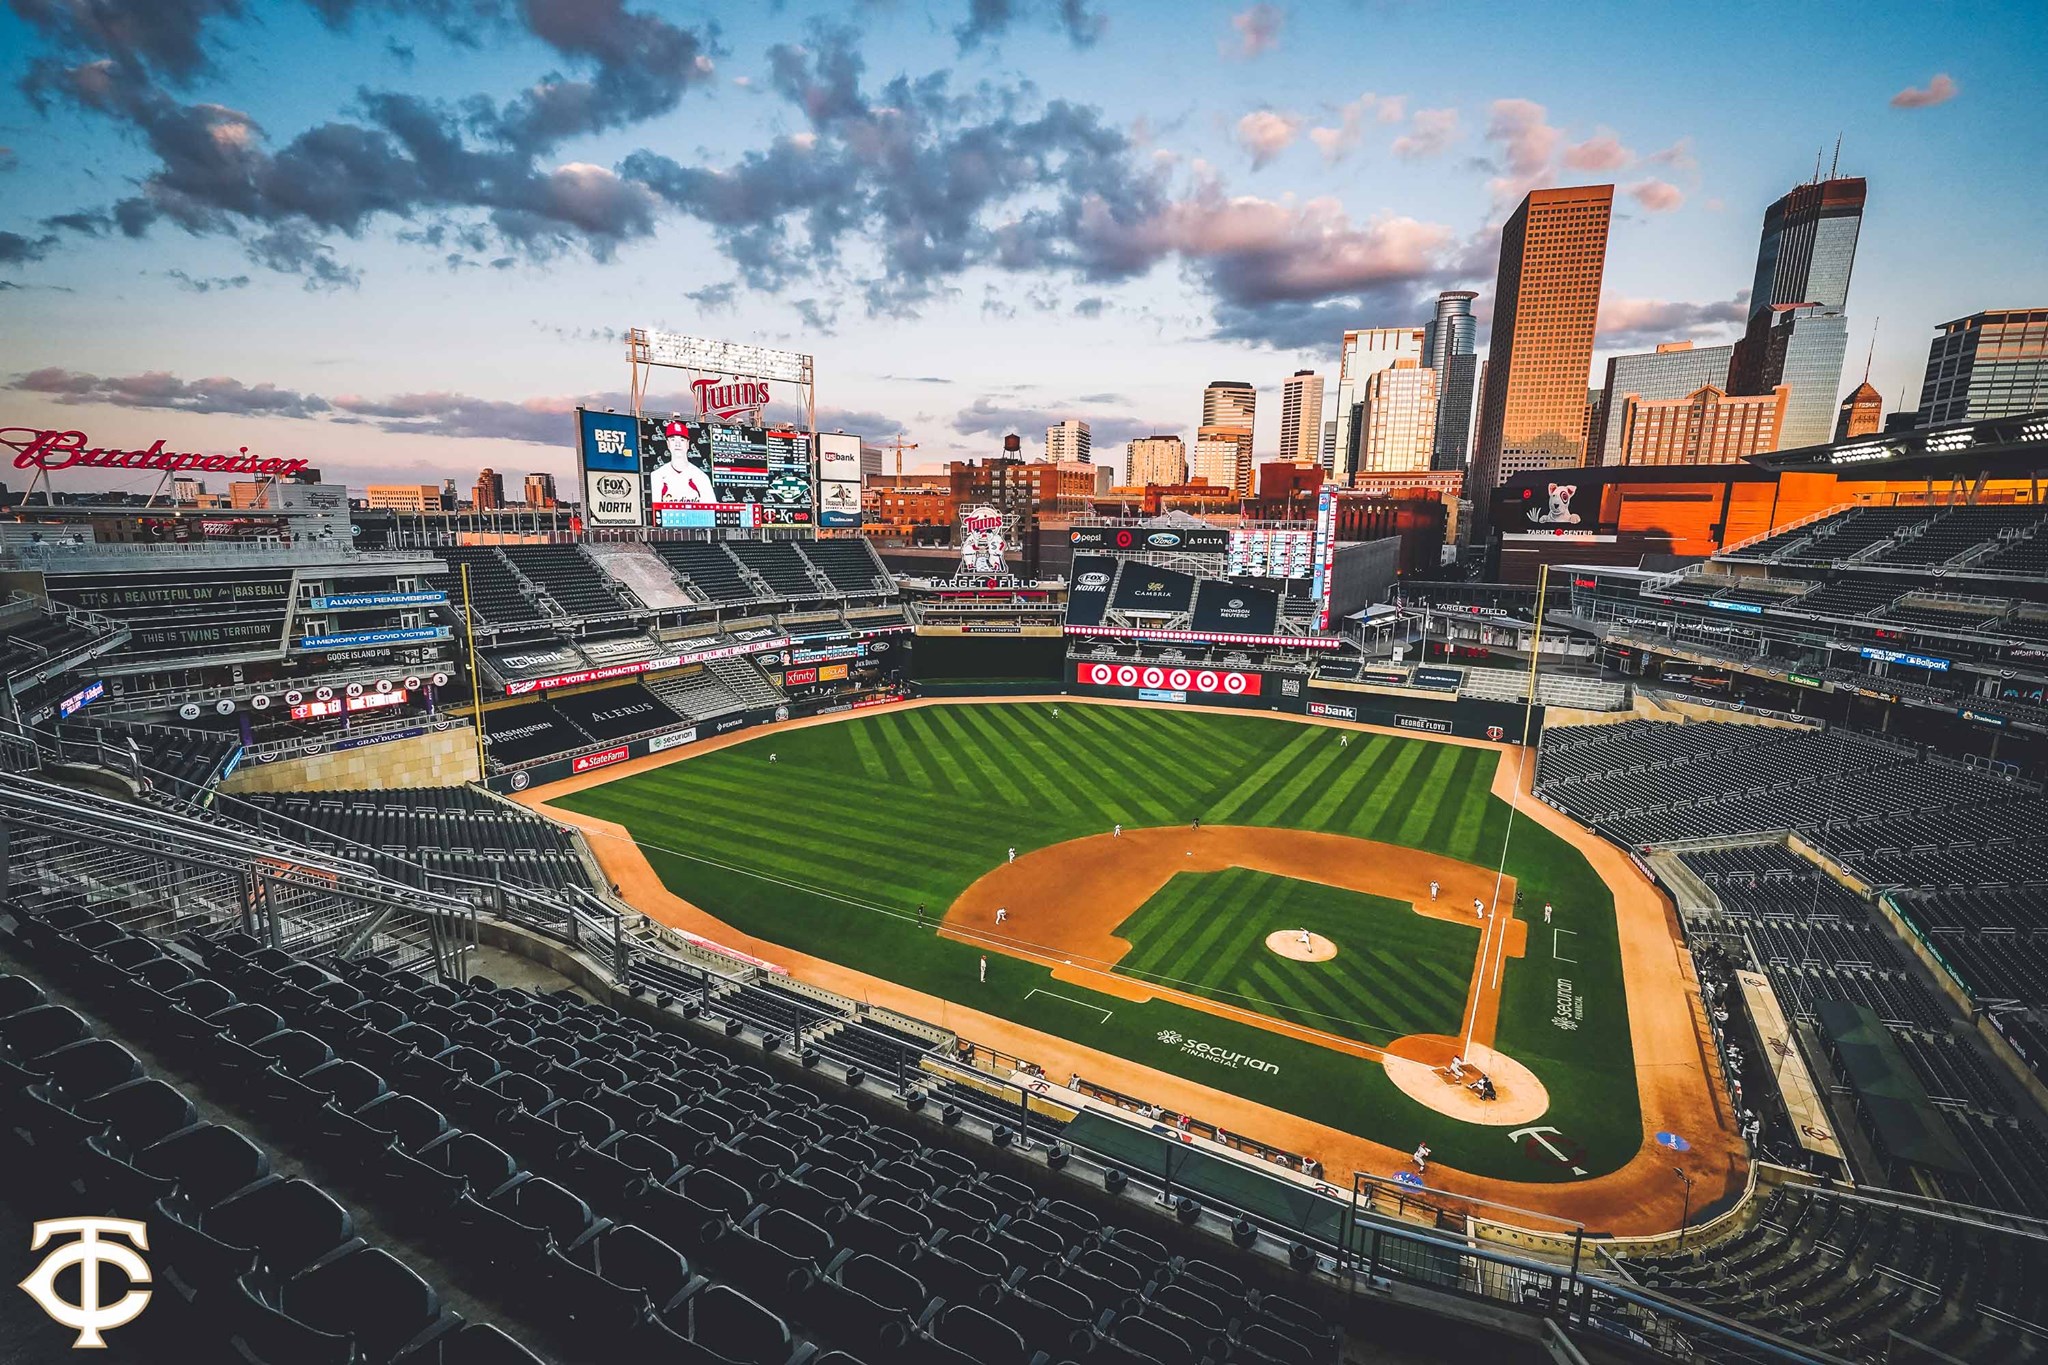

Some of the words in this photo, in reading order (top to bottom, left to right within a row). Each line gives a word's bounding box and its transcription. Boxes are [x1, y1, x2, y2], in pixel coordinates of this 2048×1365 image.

[690, 375, 770, 420] Twins
[594, 429, 626, 443] BEST
[712, 434, 751, 443] O'NEILL
[0, 427, 309, 475] Budweiser
[598, 442, 625, 455] BUY
[603, 479, 624, 490] FOX
[598, 501, 632, 513] NORTH
[964, 515, 1002, 534] Twins
[1081, 534, 1101, 543] pepsi
[1154, 535, 1173, 544] Ford
[930, 580, 986, 588] TARGET
[1000, 580, 1039, 588] FIELD
[80, 591, 108, 605] IT'S
[113, 592, 121, 603] A
[124, 589, 191, 603] BEAUTIFUL
[194, 588, 213, 599] DAY
[235, 585, 286, 597] BASEBALL
[330, 597, 373, 606] ALWAYS
[374, 594, 442, 604] REMEMBERED
[1436, 603, 1471, 612] TARGET
[1480, 608, 1507, 616] FIELD
[142, 632, 165, 643] THIS
[167, 632, 177, 641] IS
[180, 629, 220, 642] TWINS
[223, 625, 271, 637] TERRITORY
[317, 636, 357, 645] MEMORY
[372, 633, 400, 641] COVID
[401, 630, 435, 638] VICTIMS
[327, 651, 350, 661] GOOSE
[351, 649, 376, 659] ISLAND
[377, 648, 391, 657] PUB
[539, 678, 560, 688] TEXT
[597, 665, 639, 678] CHARACTER
[788, 671, 814, 683] xfinity
[350, 686, 359, 694] 14
[185, 708, 196, 716] 42
[591, 702, 654, 722] ALERUS
[722, 719, 743, 729] PENTAIR
[1401, 718, 1424, 728] GEORGE
[1426, 722, 1446, 731] FLOYD
[491, 722, 552, 740] RASMUSSEN
[497, 731, 535, 743] COLLEGE
[663, 731, 693, 743] securian
[357, 736, 380, 746] GRAY
[381, 734, 404, 743] DUCK
[1557, 978, 1572, 1018] securian
[1575, 995, 1583, 1021] FINANCIAL
[1180, 1046, 1238, 1069] FINANCIAL
[1184, 1038, 1280, 1075] securian
